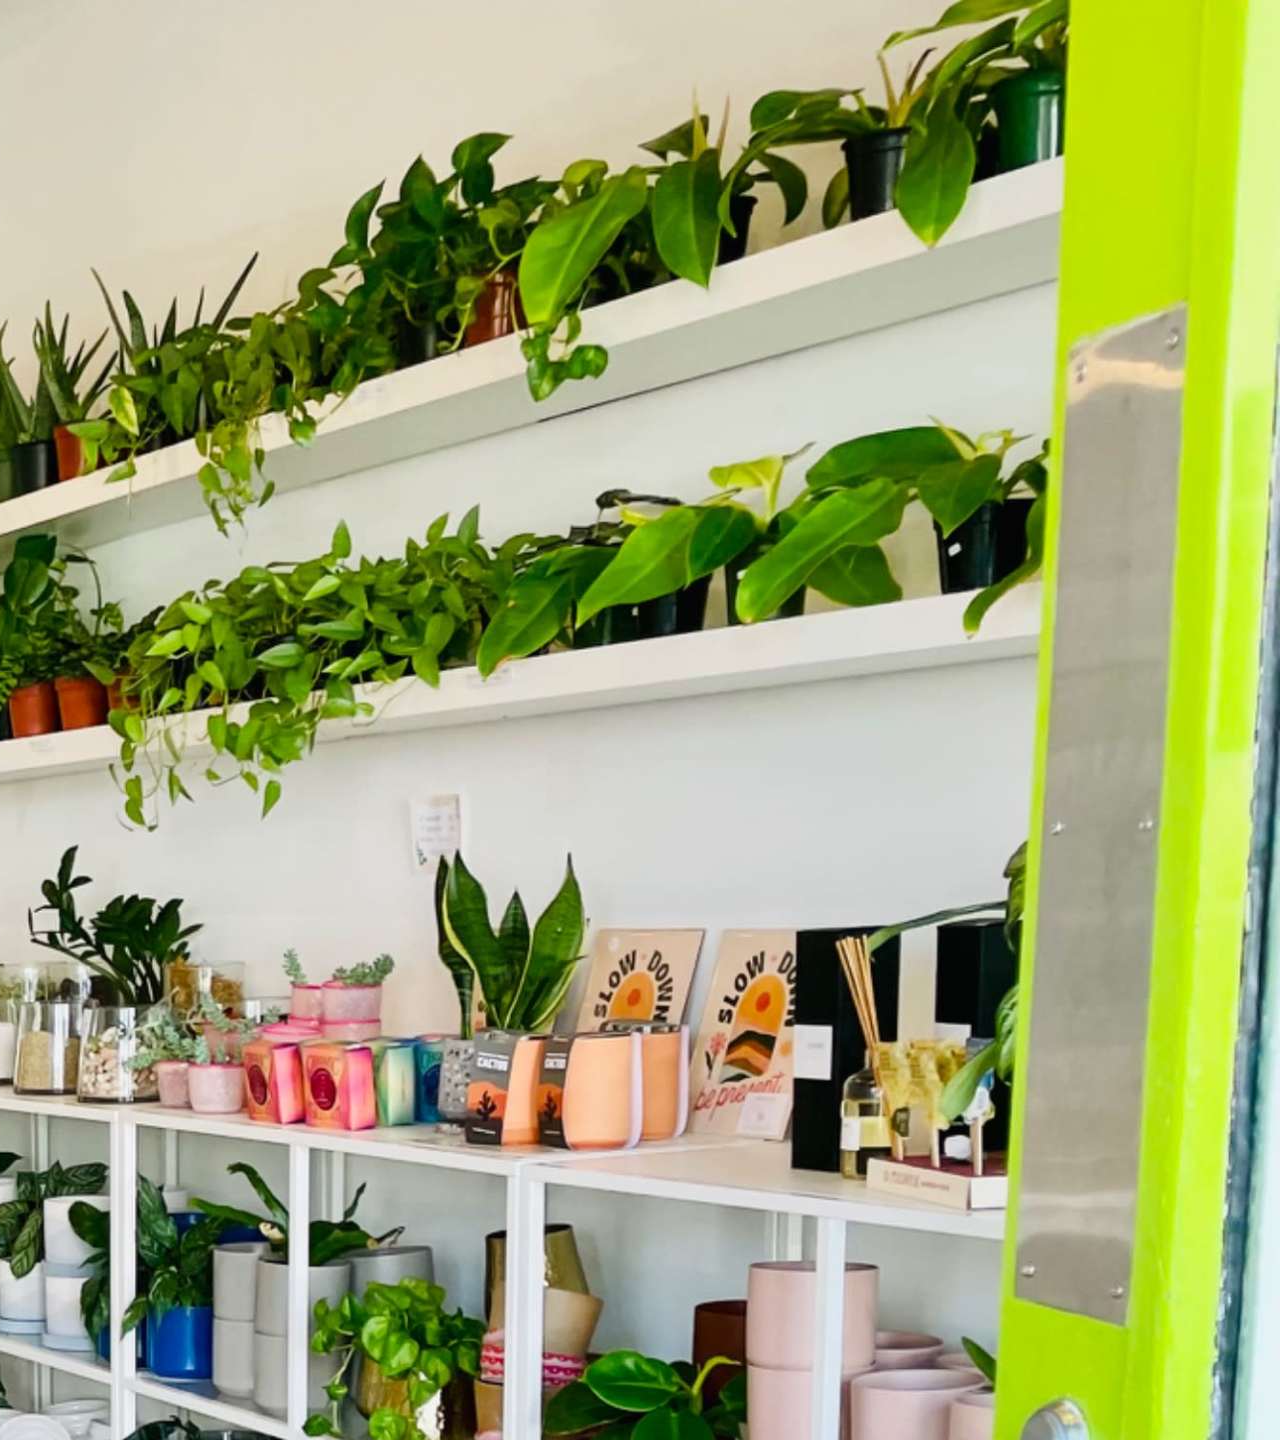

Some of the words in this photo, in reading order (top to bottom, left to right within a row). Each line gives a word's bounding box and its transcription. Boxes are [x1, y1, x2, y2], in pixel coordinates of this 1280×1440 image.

[594, 950, 637, 1019] SLOW
[647, 949, 674, 1021] DOWN
[718, 951, 765, 1024] SLOW
[694, 1089, 716, 1111] be
